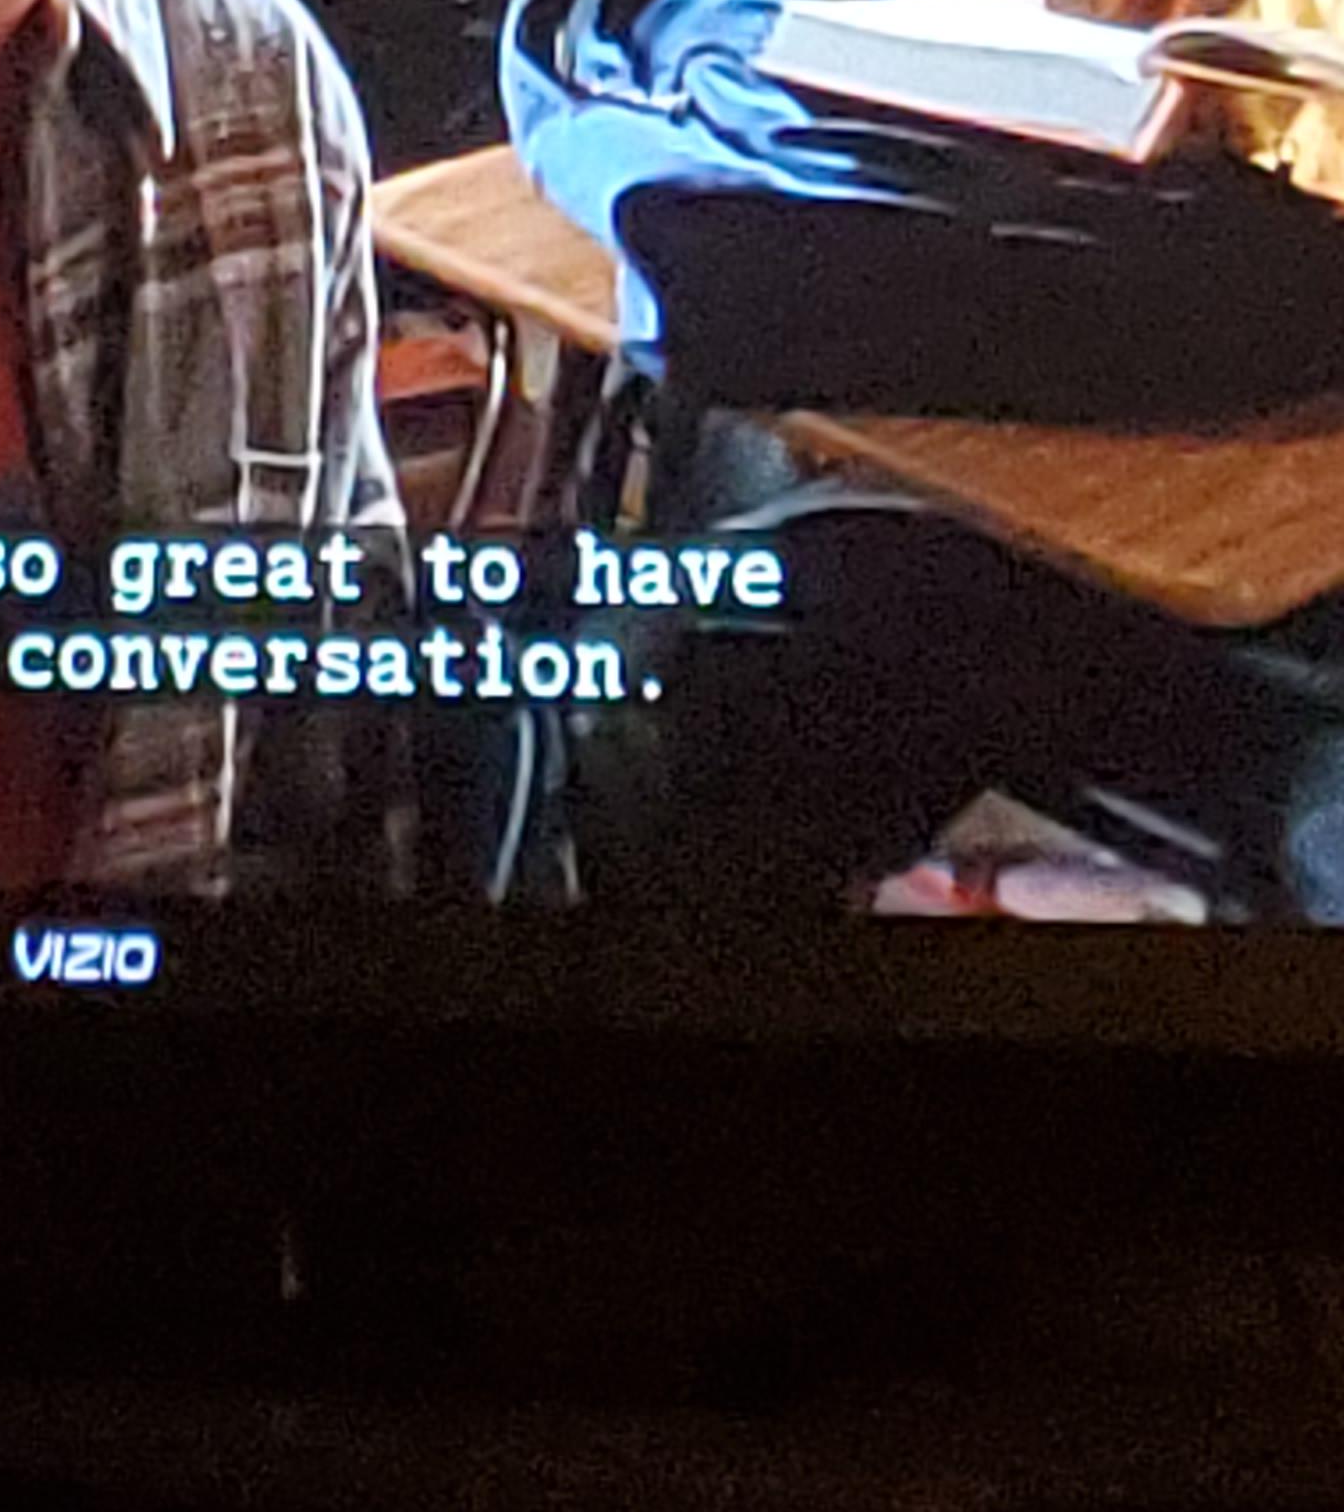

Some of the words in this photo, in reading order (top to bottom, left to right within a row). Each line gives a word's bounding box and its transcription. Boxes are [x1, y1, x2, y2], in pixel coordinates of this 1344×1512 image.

[109, 533, 363, 609] great
[421, 533, 522, 604] to
[574, 531, 784, 608] have
[6, 622, 664, 703] conversation.
[12, 926, 157, 982] VIZIO
